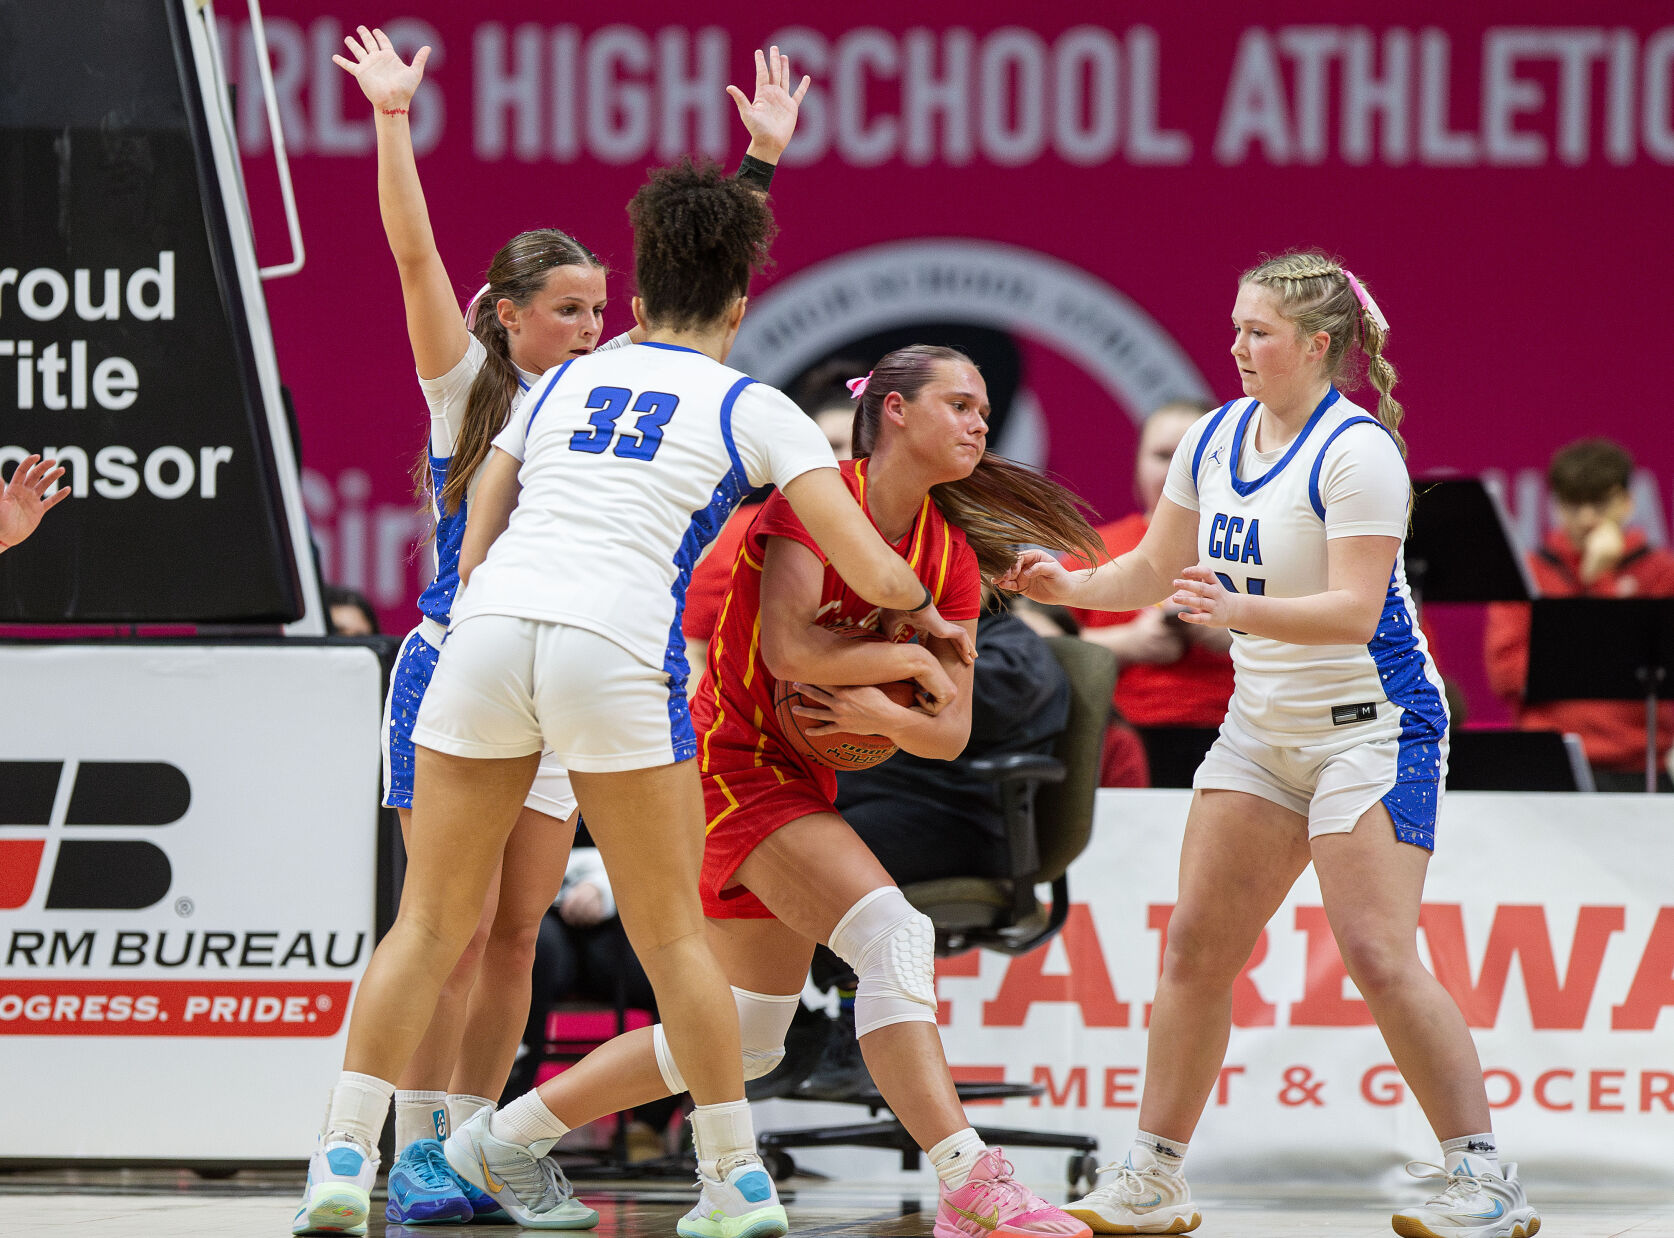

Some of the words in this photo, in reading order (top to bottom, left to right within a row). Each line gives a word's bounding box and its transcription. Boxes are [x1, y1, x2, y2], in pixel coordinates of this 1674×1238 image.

[474, 22, 731, 165] HIGH
[765, 25, 1194, 168] SCHOOL
[569, 386, 680, 461] 33
[1208, 513, 1263, 565] CCA
[1361, 706, 1371, 715] M
[5, 930, 97, 968] RM
[110, 930, 366, 969] BUREAU
[1030, 1065, 1246, 1110] MET
[1277, 1064, 1326, 1108] &
[1359, 1063, 1674, 1113] GOCER
